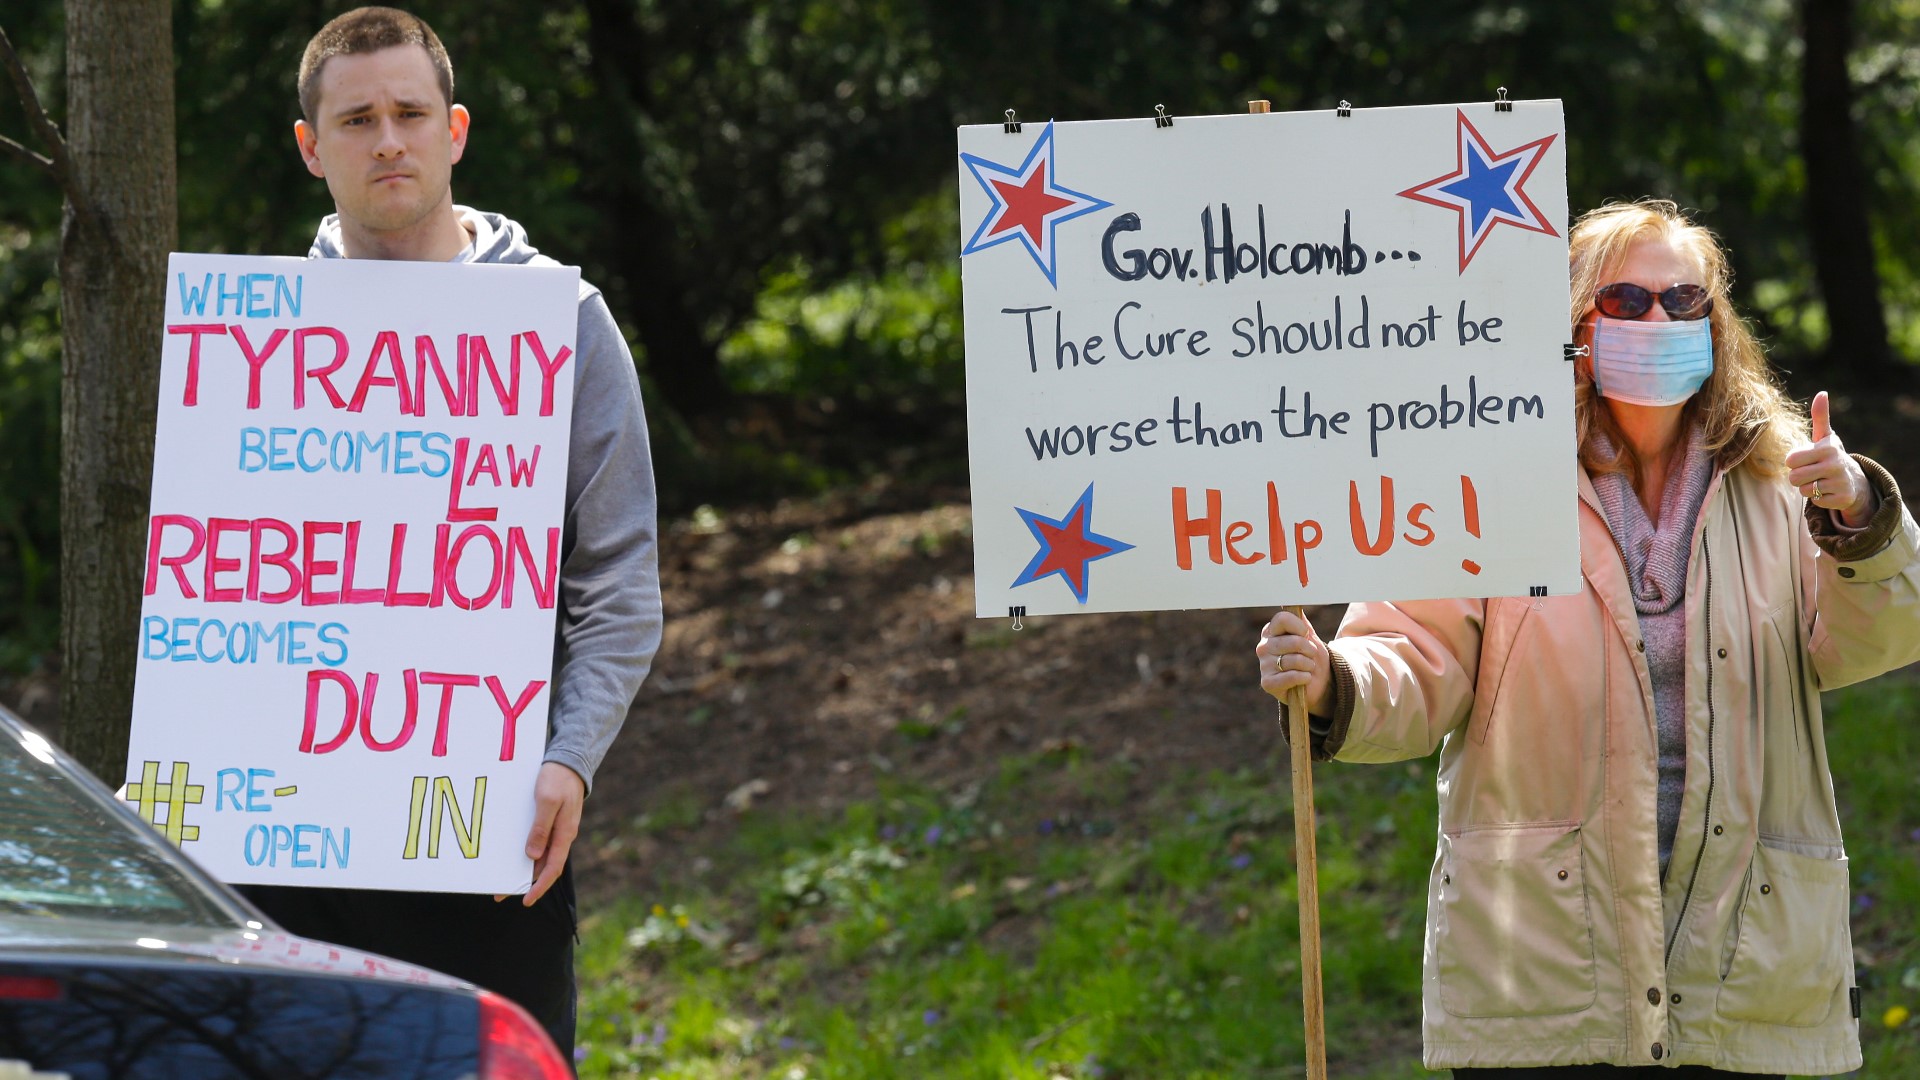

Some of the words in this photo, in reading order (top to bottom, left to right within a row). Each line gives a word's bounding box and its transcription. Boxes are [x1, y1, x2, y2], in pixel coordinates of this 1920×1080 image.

[178, 272, 301, 316] WHEN
[1001, 305, 1105, 371] The
[1113, 301, 1210, 359] Cure
[1382, 305, 1442, 349] not
[1457, 300, 1503, 343] be
[167, 324, 572, 415] TYRANNY
[1025, 419, 1158, 459] worse
[1167, 396, 1263, 446] than
[1270, 386, 1350, 438] the
[1369, 375, 1544, 456] problem
[239, 427, 451, 476] BECOMES
[446, 437, 540, 521] LAW
[144, 514, 559, 609] REBELLION
[1171, 480, 1322, 587] Help
[142, 615, 349, 665] BECOMES
[298, 668, 546, 760] DUTY
[243, 824, 349, 867] OPEN
[402, 776, 486, 858] IN
